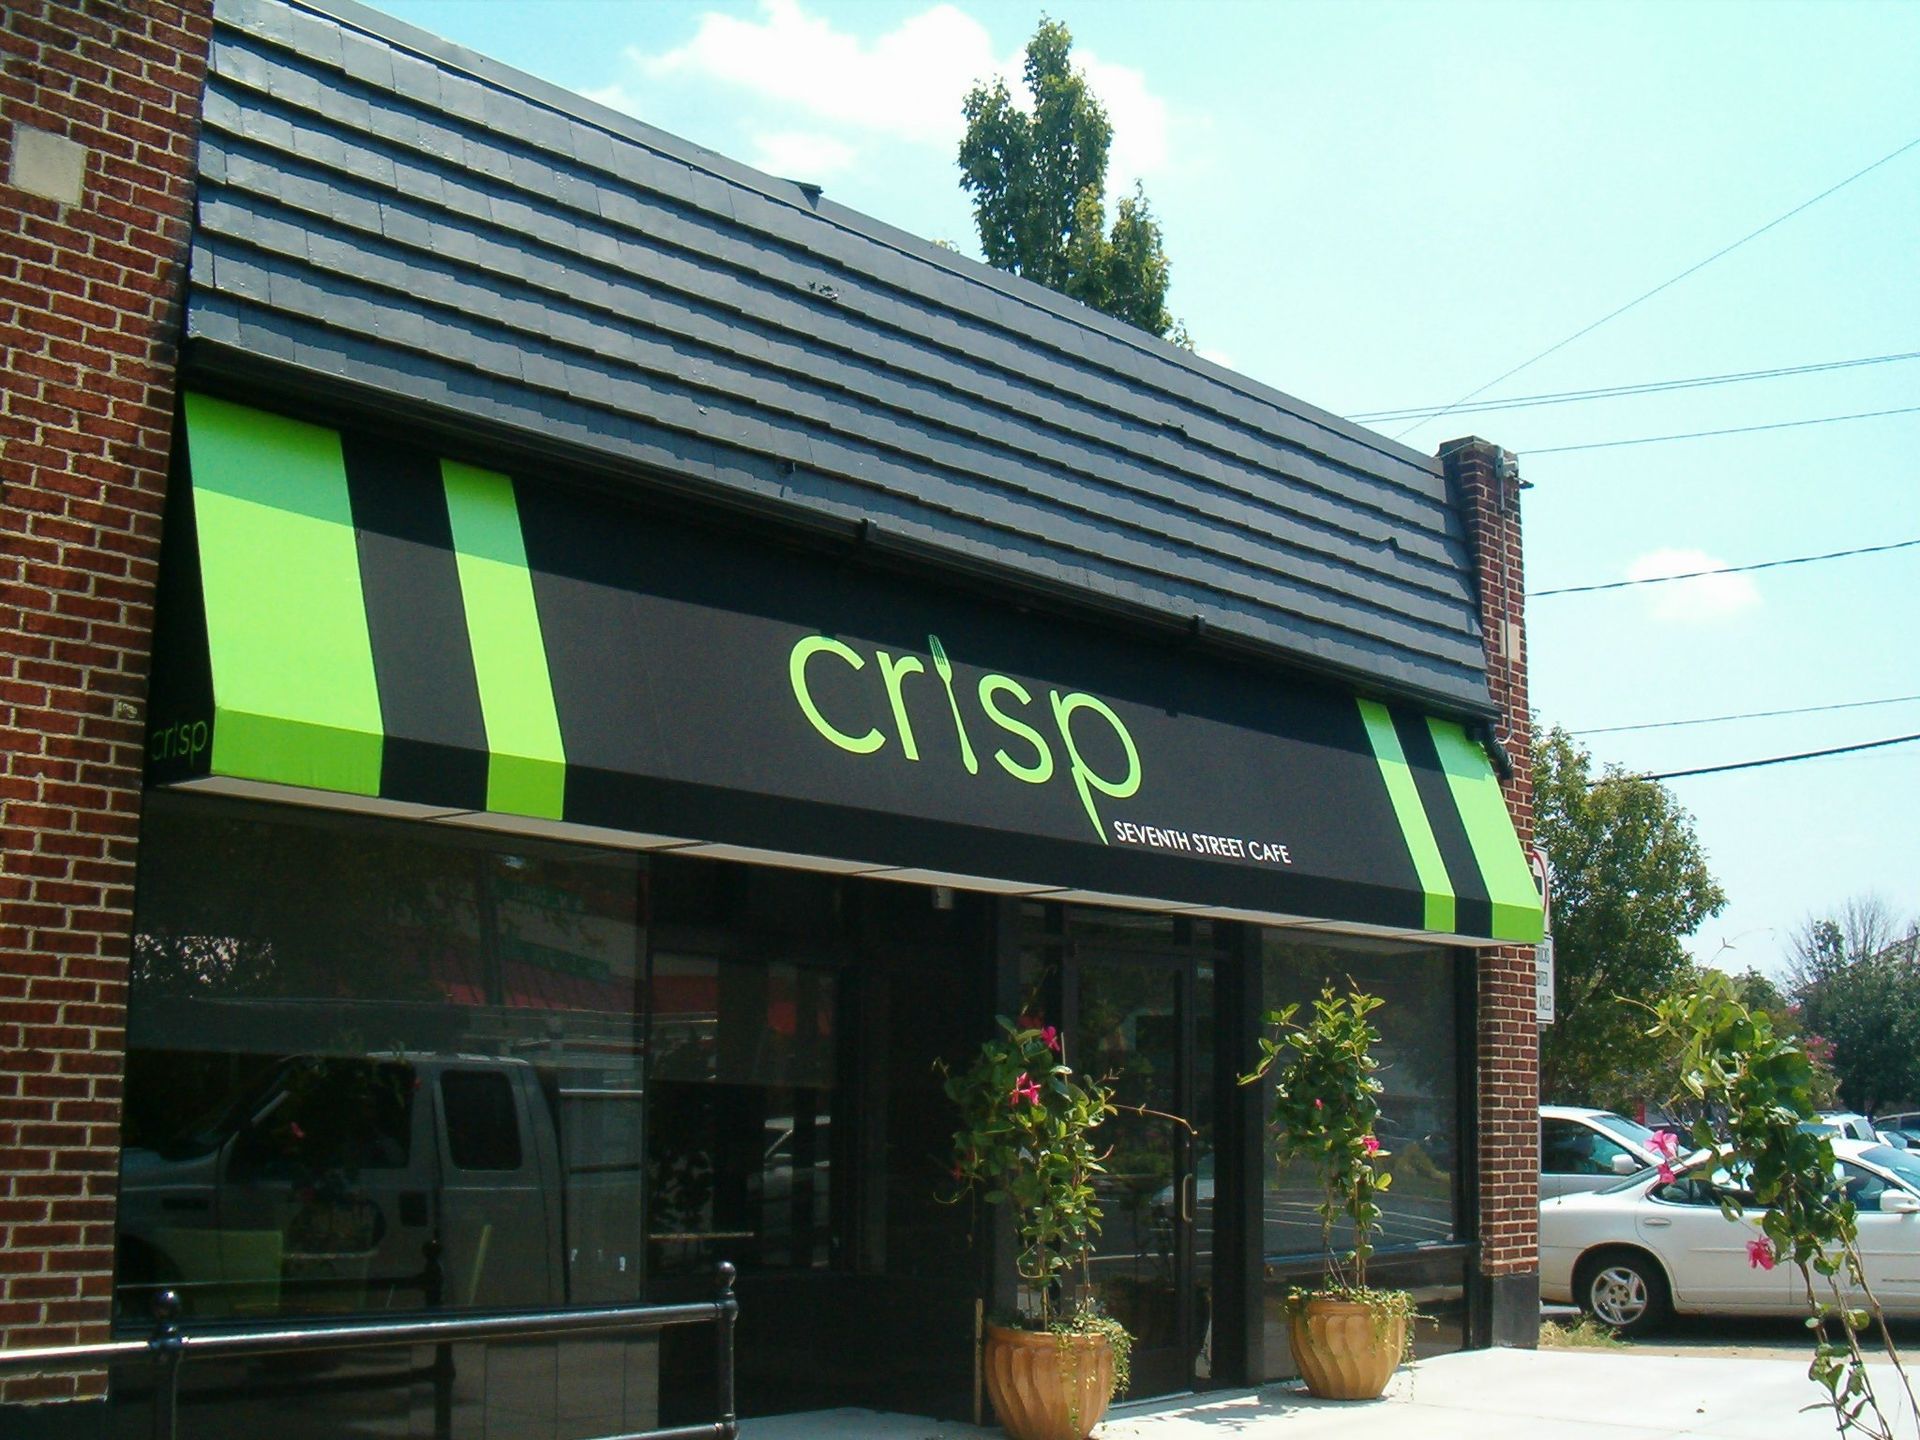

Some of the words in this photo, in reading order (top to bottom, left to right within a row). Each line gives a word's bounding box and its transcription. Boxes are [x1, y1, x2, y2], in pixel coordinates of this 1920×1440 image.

[151, 720, 208, 769] crisp
[789, 634, 1141, 845] crisp
[1113, 820, 1191, 851] SEVENTH
[1191, 832, 1246, 858] STREET
[1248, 840, 1292, 864] CAFE
